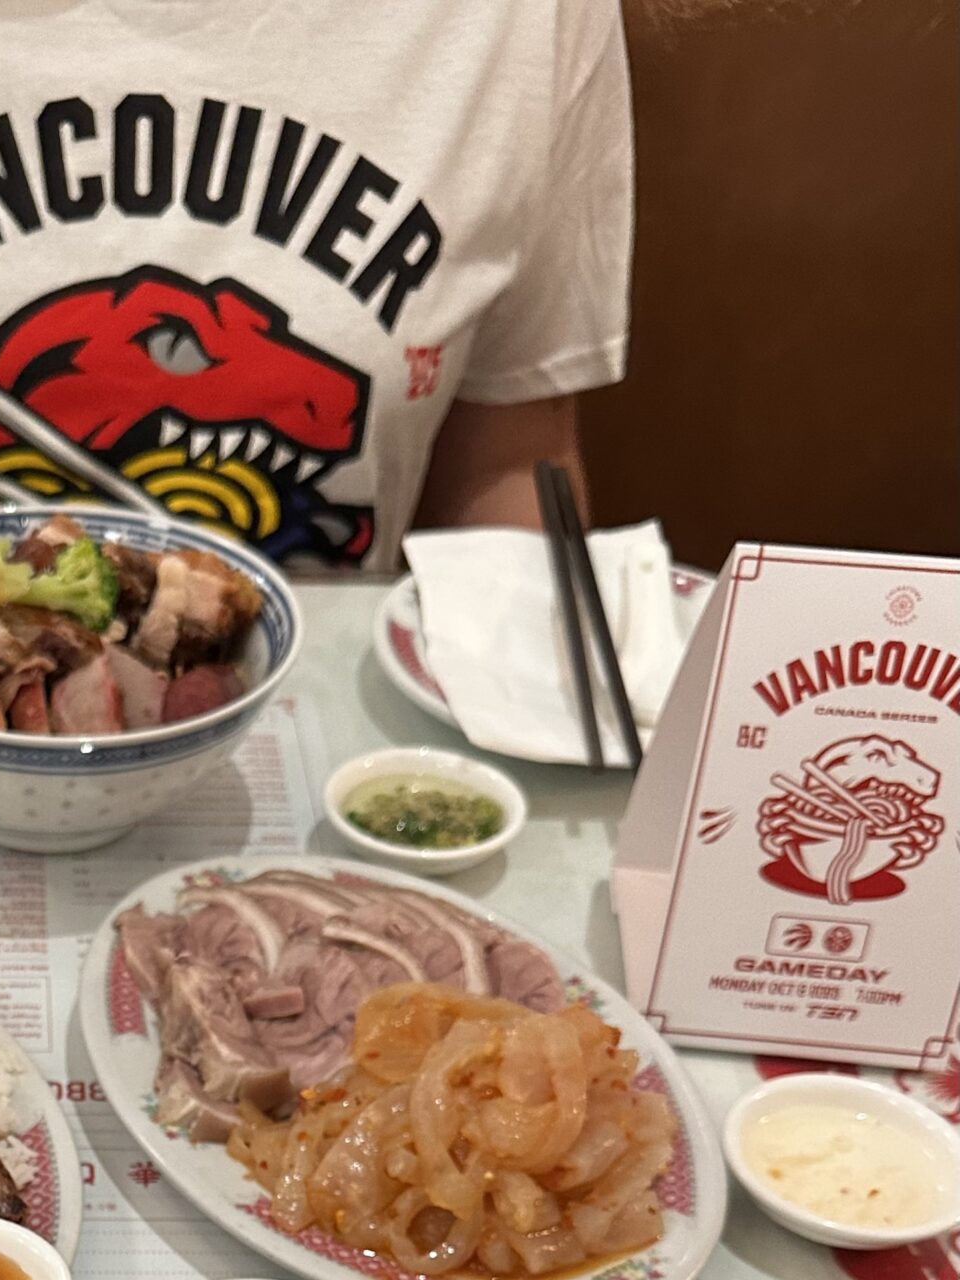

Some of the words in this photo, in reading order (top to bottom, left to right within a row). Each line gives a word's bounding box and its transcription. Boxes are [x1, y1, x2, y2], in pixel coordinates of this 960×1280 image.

[753, 641, 960, 717] VANCOUV
[814, 706, 877, 719] CANADA
[881, 711, 938, 724] SERIES
[737, 725, 767, 749] BC
[734, 957, 889, 983] GAMEDAY
[708, 975, 765, 992] MONDAY
[768, 981, 793, 995] OCT
